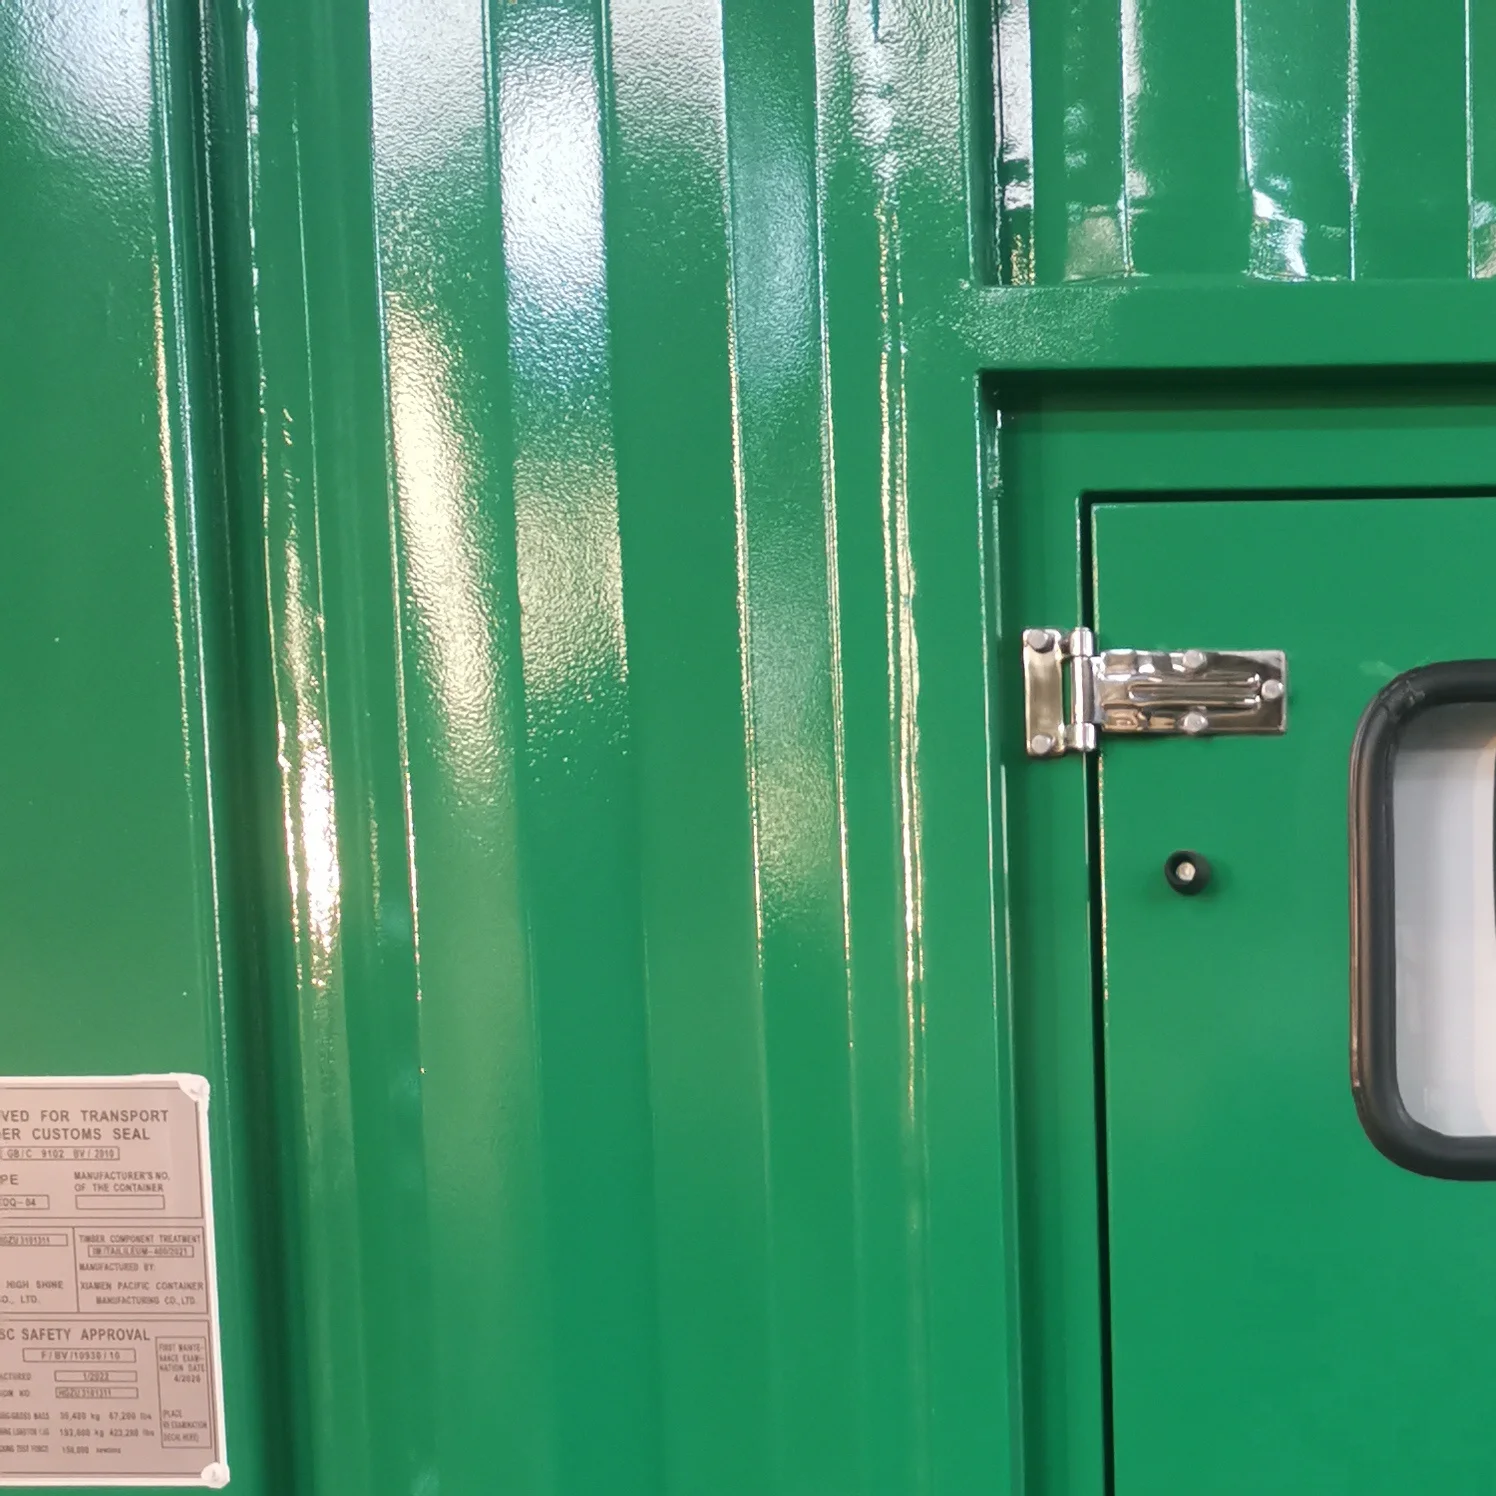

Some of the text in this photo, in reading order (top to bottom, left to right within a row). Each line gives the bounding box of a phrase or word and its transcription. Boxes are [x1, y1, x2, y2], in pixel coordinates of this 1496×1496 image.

[40, 1109, 70, 1122] FOR
[80, 1109, 169, 1122] TRANSPORT
[0, 1127, 151, 1140] ER CUSTOMS SEAL
[74, 1183, 164, 1192] OF THE CONTAINER
[79, 1234, 201, 1244] TIMBER COMPONENT TREATMENT
[79, 1262, 139, 1272] MANUFACTURED
[6, 1280, 64, 1290] HIGH SHINE
[80, 1281, 205, 1291] XIAMEN PACIFIC CONTAINER
[96, 1295, 160, 1305] MANUFACTURING
[21, 1328, 71, 1341] SAFETY
[80, 1328, 150, 1341] APPROVAL
